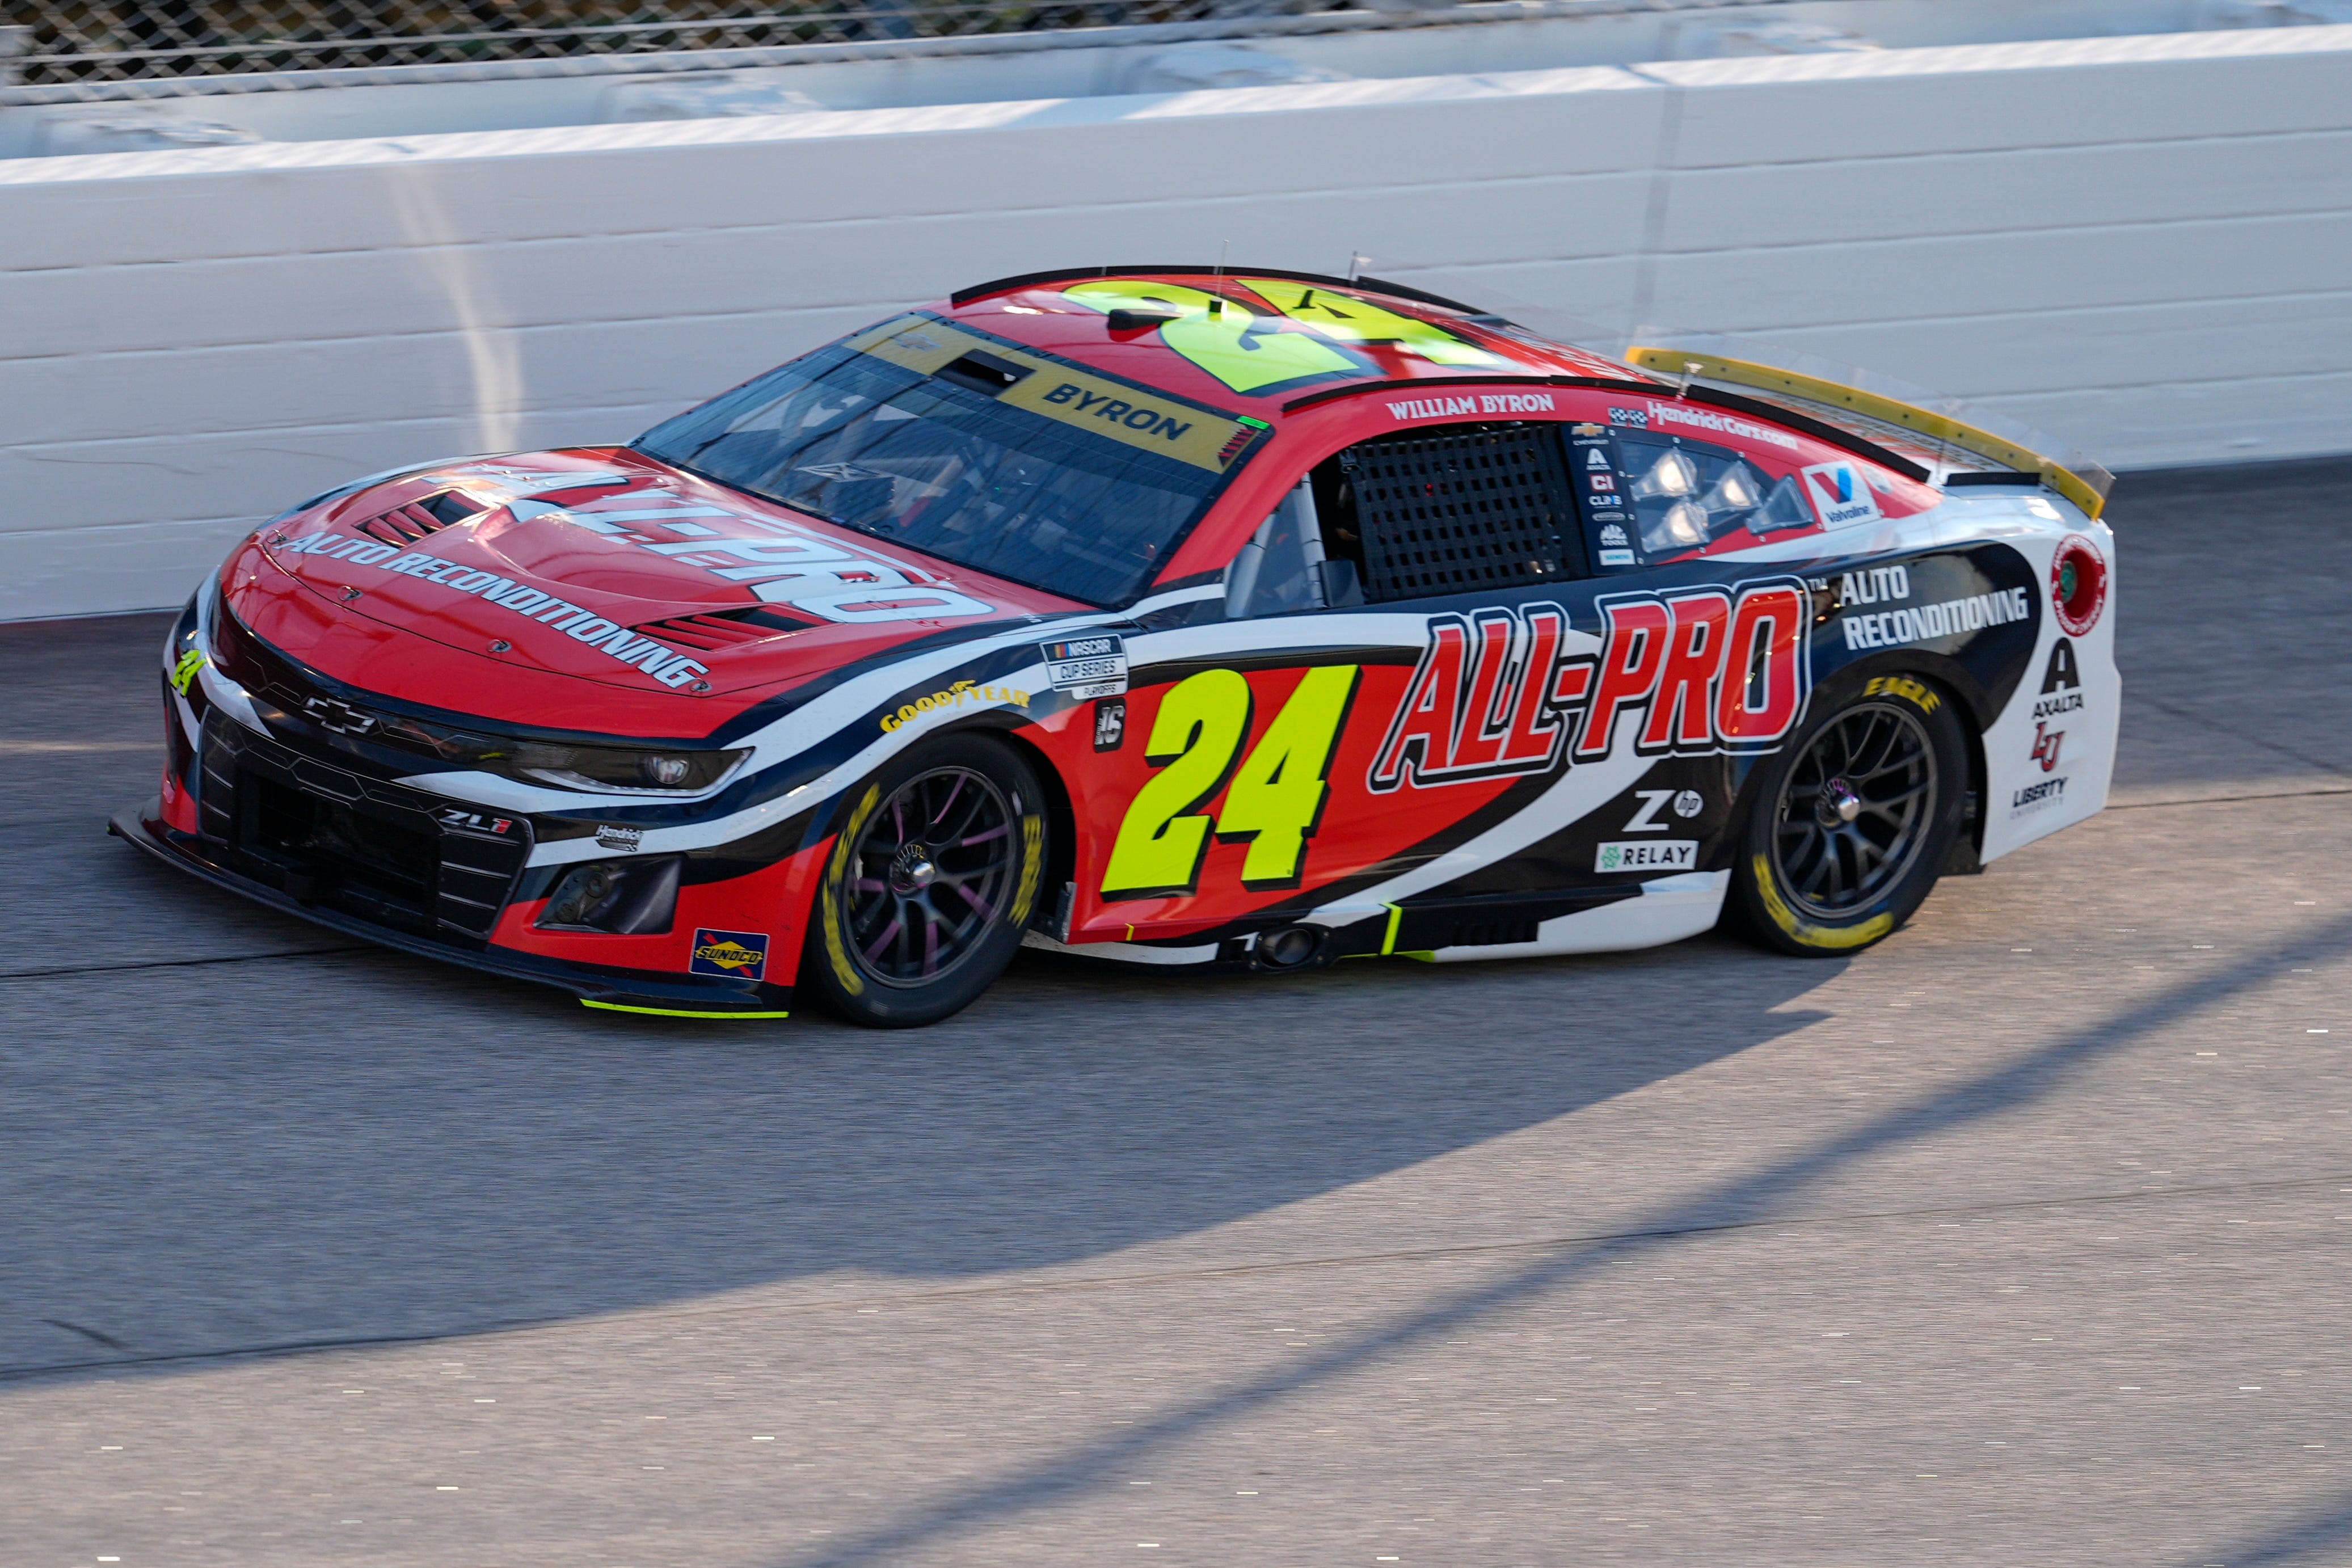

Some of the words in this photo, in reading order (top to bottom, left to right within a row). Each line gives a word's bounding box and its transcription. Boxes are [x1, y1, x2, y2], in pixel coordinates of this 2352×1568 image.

[1062, 280, 1502, 393] 24
[1042, 382, 1192, 441] BYRON
[1385, 396, 1478, 420] WILLIAM
[1480, 394, 1556, 412] BYRON
[1826, 504, 1870, 523] Valvoline
[1840, 566, 1910, 607] AUTO
[273, 531, 401, 564] AUTO
[377, 552, 710, 689] RECONDITIONING
[1841, 587, 2029, 650] RECONDITIONING
[1069, 638, 1112, 657] NASCAR
[1060, 664, 1079, 678] CUP
[1082, 660, 1116, 676] SERIES
[1366, 575, 1813, 794] ALL-PRO
[880, 680, 1030, 733] GOODYEAR
[1084, 684, 1116, 696] PLAYOFFS
[1862, 676, 1941, 715] EAGLE
[2032, 693, 2084, 720] AXALTA
[1101, 664, 1359, 895] 24
[2012, 777, 2069, 808] LIBERTY
[439, 808, 513, 834] ZL1
[1621, 789, 1676, 832] Z
[1622, 847, 1692, 865] RELAY
[698, 947, 759, 963] SUNOCO
